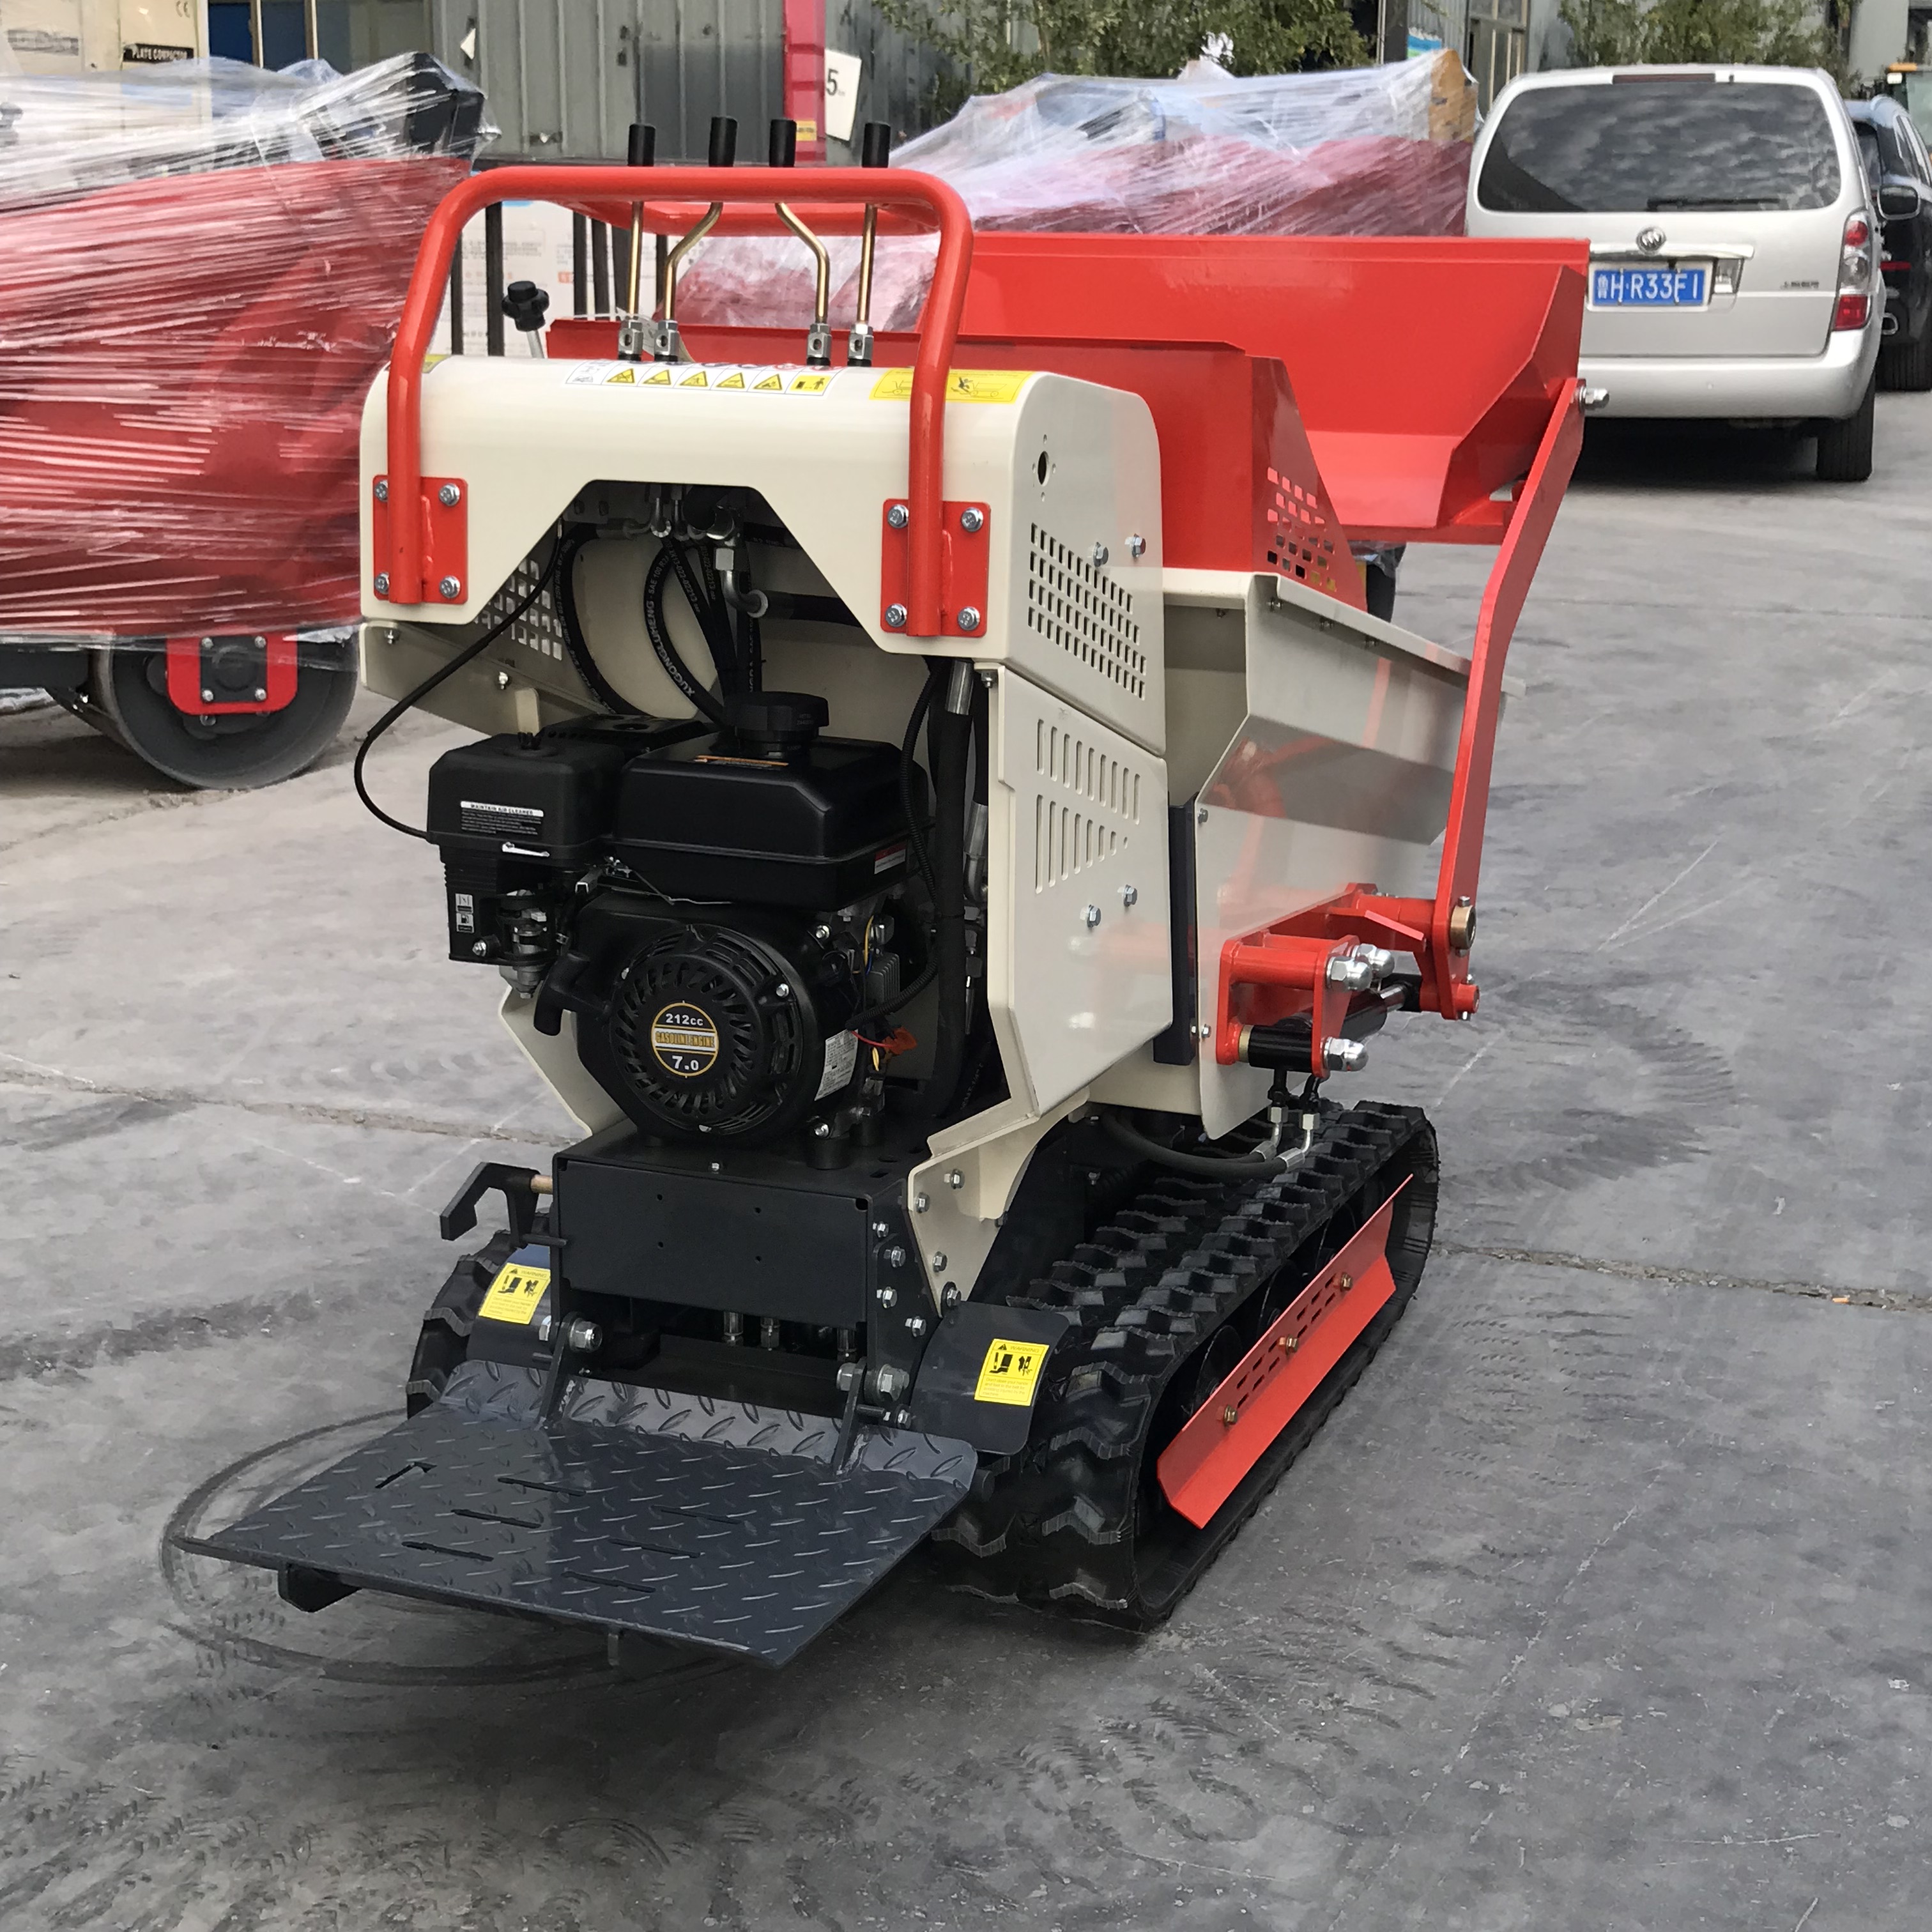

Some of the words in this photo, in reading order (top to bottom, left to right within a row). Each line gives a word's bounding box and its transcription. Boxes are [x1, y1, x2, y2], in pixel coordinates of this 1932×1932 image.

[648, 579, 657, 594] SAE
[653, 566, 663, 578] 100
[666, 1013, 703, 1026] 212cc
[656, 1031, 689, 1045] GASOLINE
[689, 1034, 716, 1048] ENGINE
[672, 1055, 700, 1071] 7.0
